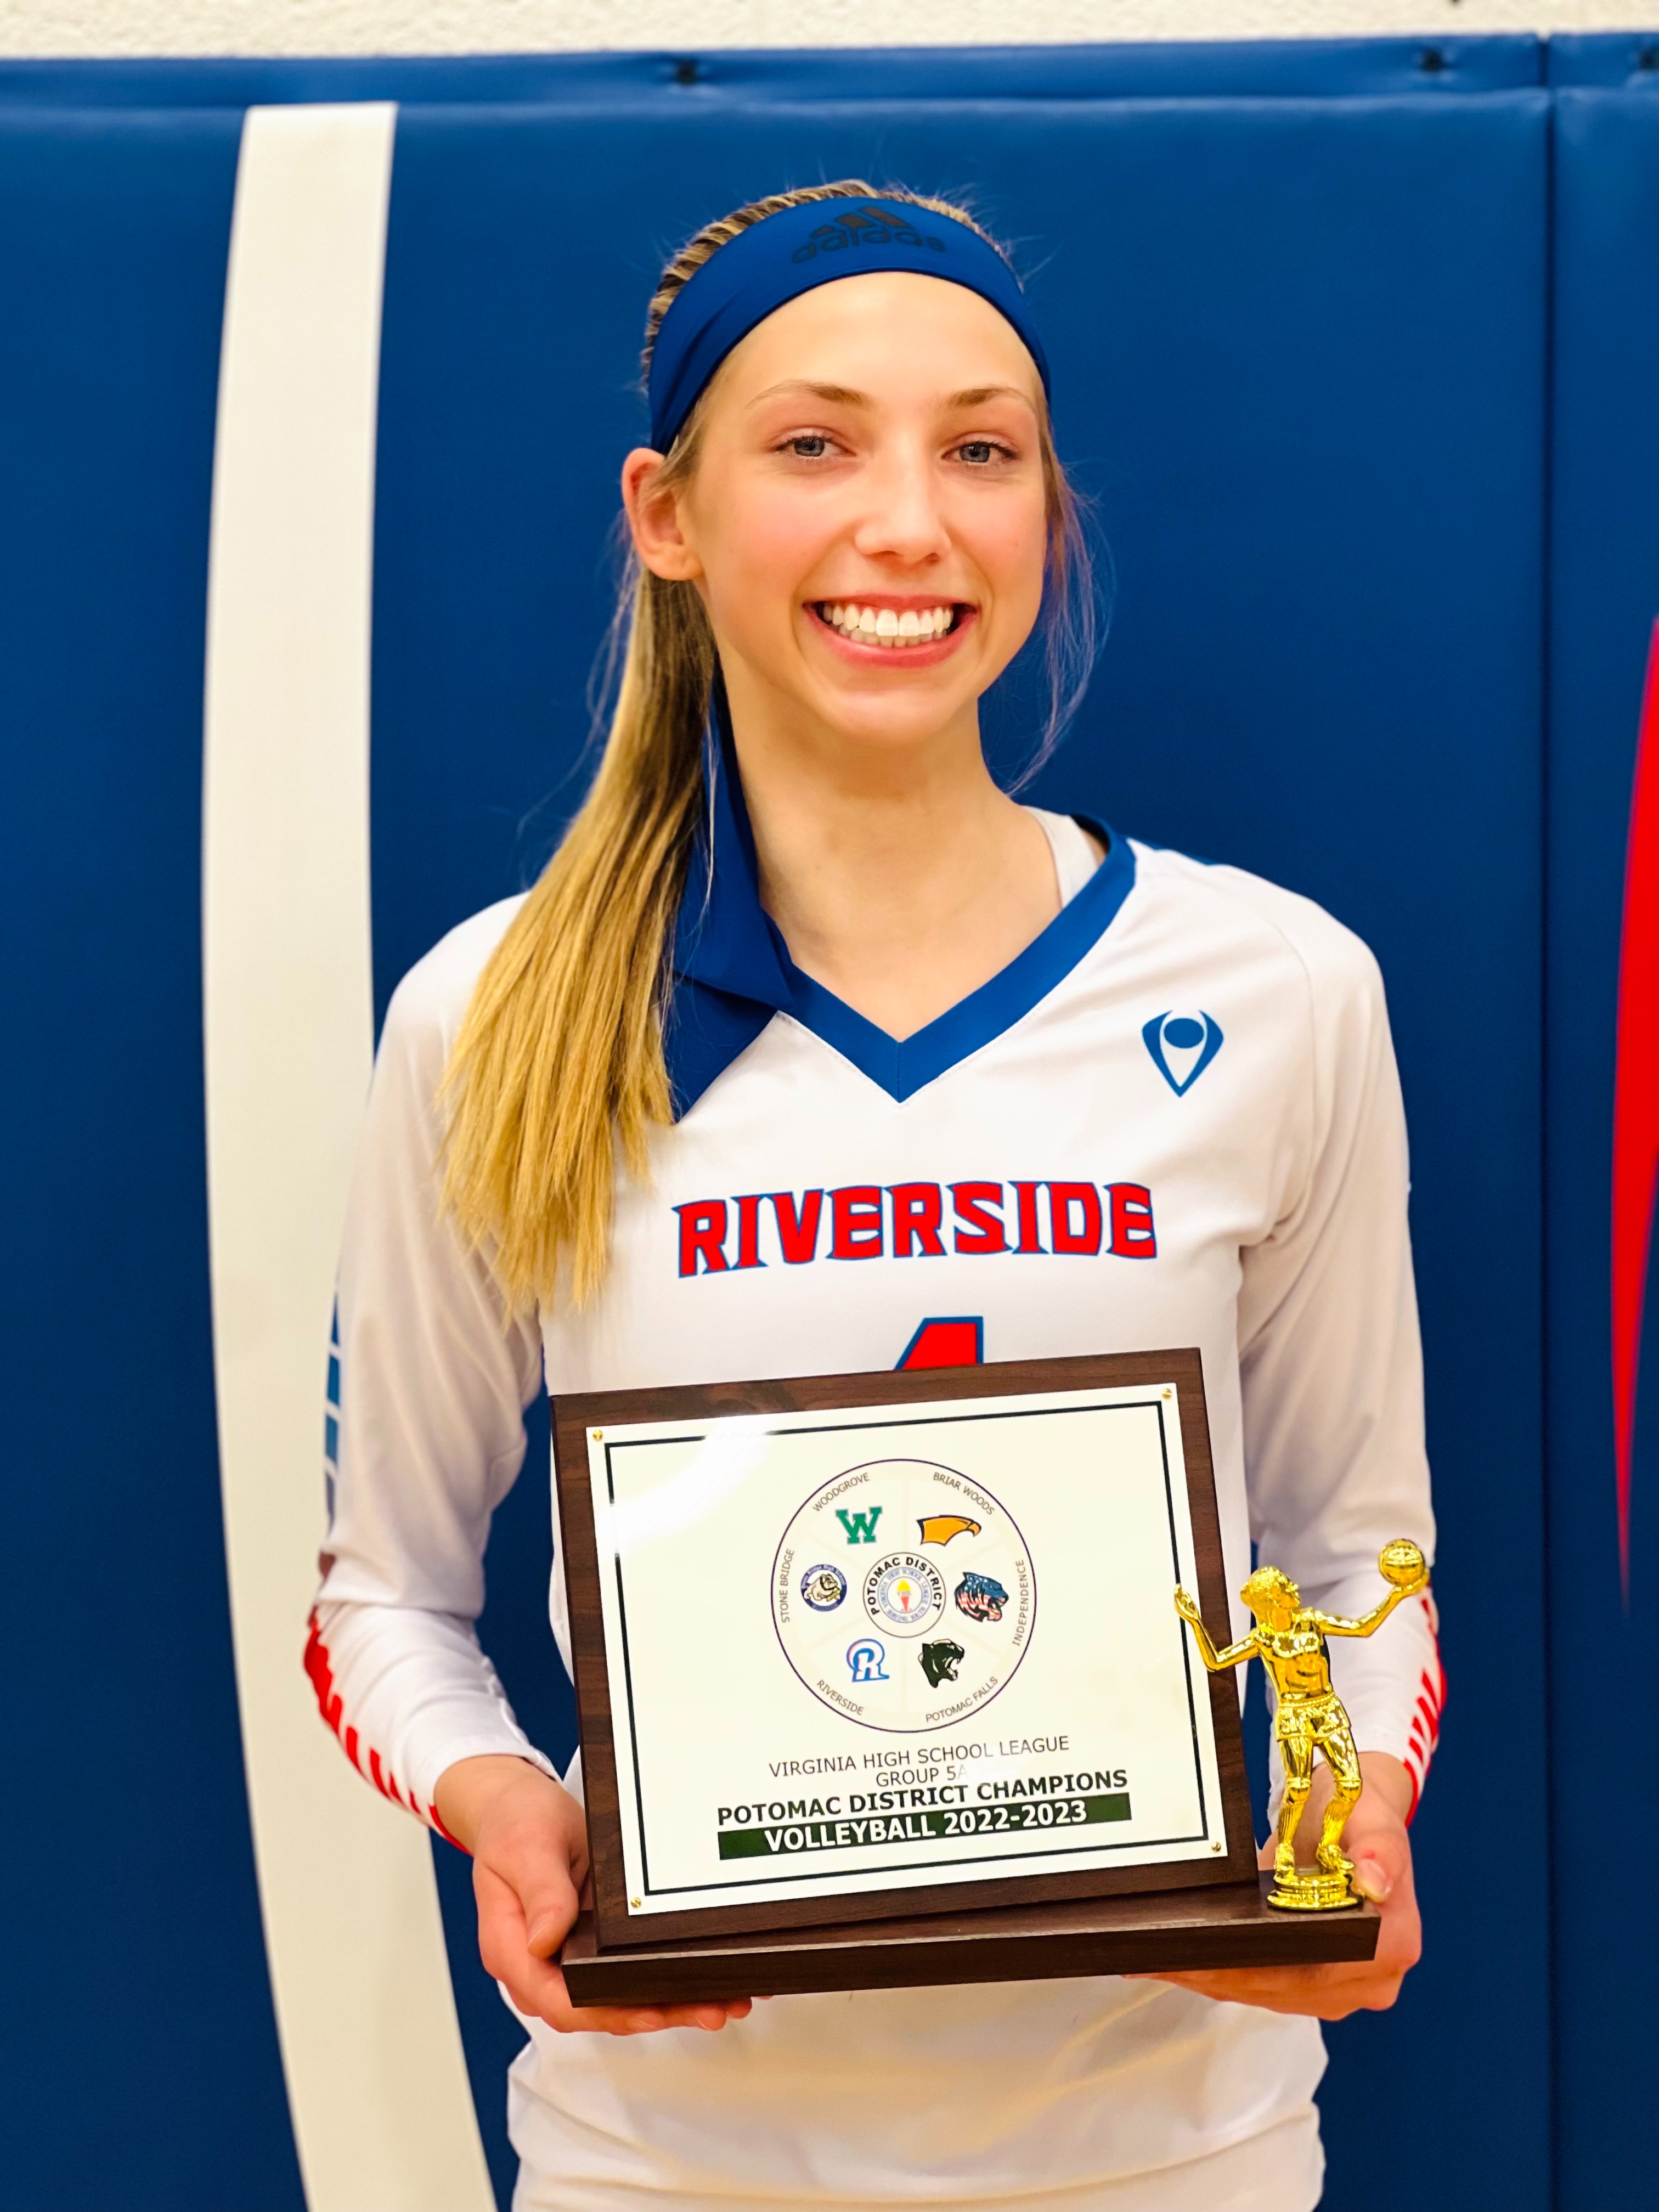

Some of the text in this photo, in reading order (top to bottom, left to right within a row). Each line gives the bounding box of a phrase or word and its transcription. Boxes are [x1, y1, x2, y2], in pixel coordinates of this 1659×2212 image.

[672, 1181, 1156, 1278] RIVERSIDE
[812, 1472, 870, 1511] WOODGROVE
[933, 1472, 995, 1515] BRIAR WOODS
[779, 1548, 795, 1623] STONE BRIDGE
[867, 1556, 943, 1615] POTOMAC DISTRICT
[1012, 1559, 1029, 1646] INDEPENDENCE
[816, 1679, 864, 1716] RIVERSIDE
[926, 1676, 998, 1723] POTOMAC FALLS
[769, 1735, 1069, 1778] VIRGINIA HIGH SCHOOL LEAGUE
[876, 1764, 968, 1787] GROUP 5A
[718, 1769, 1128, 1826] POTOMAC DISTRICT CHAMPIONS
[764, 1800, 1087, 1852] VOLLEYBALL 2022-2023
